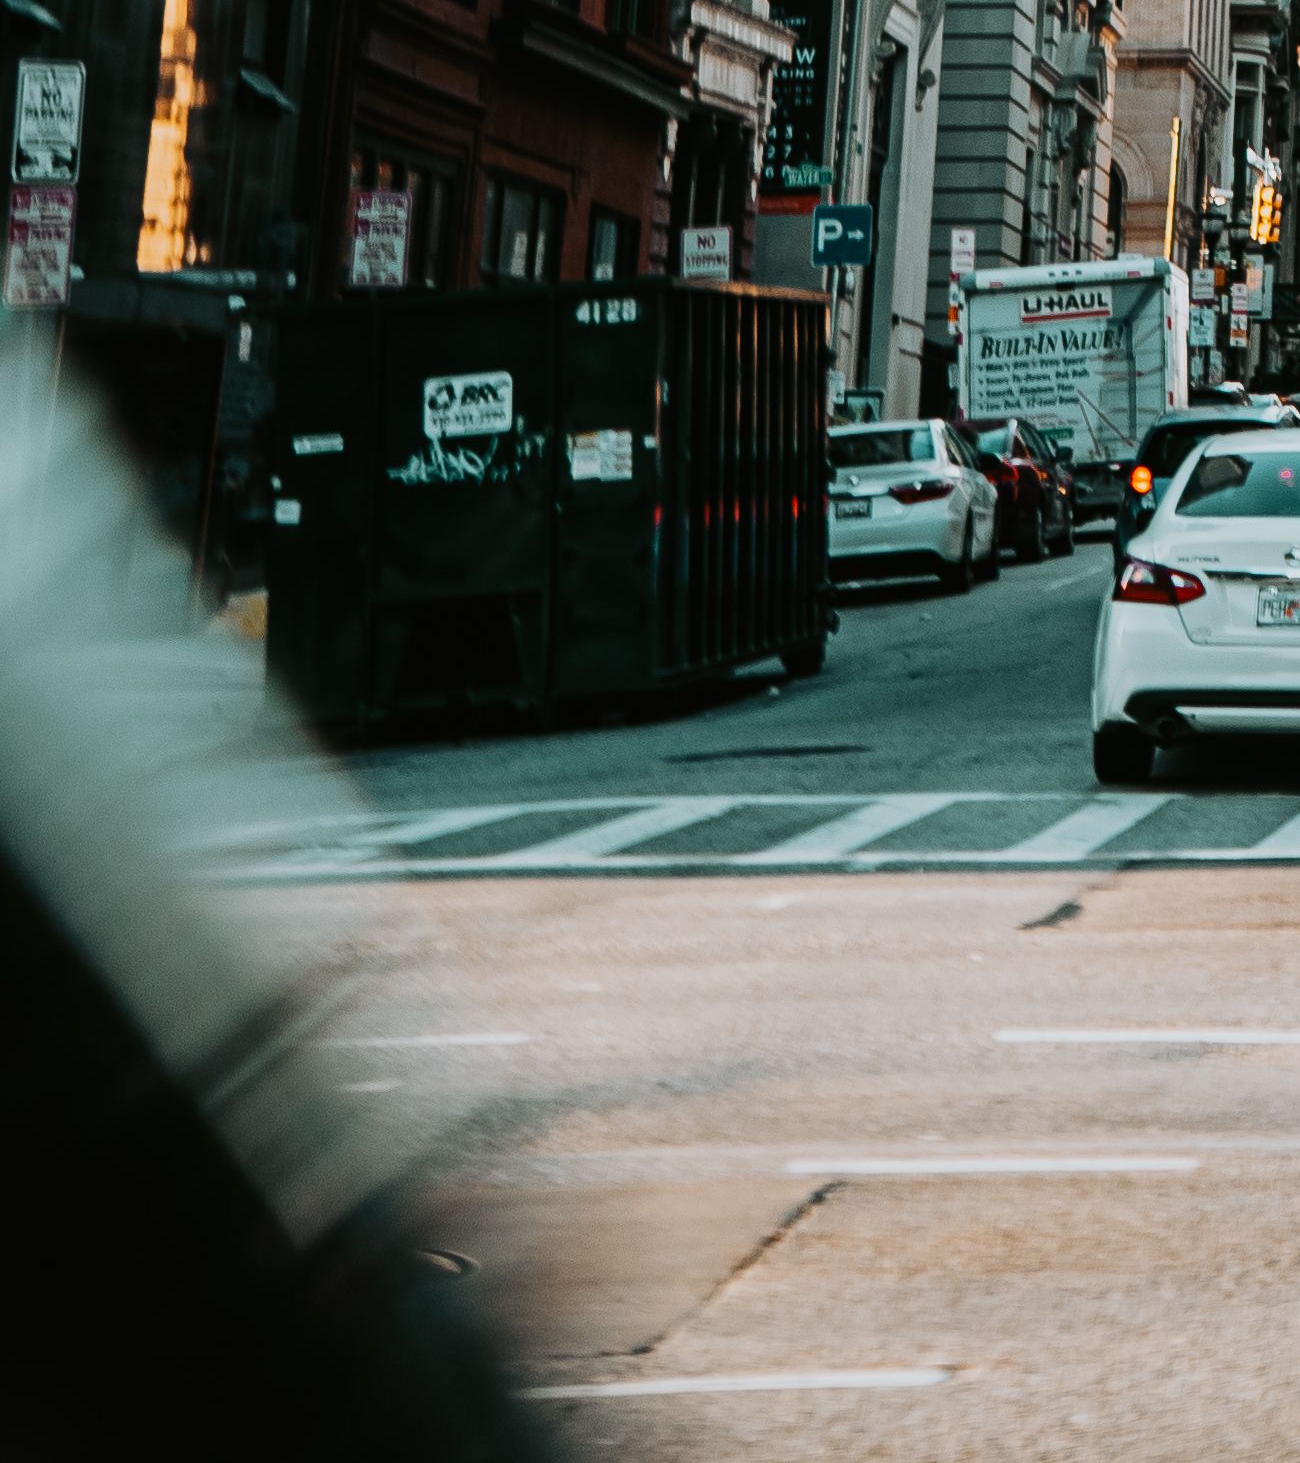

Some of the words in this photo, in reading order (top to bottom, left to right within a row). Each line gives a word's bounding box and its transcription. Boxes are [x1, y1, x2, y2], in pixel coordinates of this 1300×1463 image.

[697, 234, 716, 249] NO
[818, 218, 843, 252] P
[1023, 293, 1109, 314] U-HAUL
[981, 331, 1058, 360] BUILT-IN
[1060, 325, 1125, 353] VALUE!
